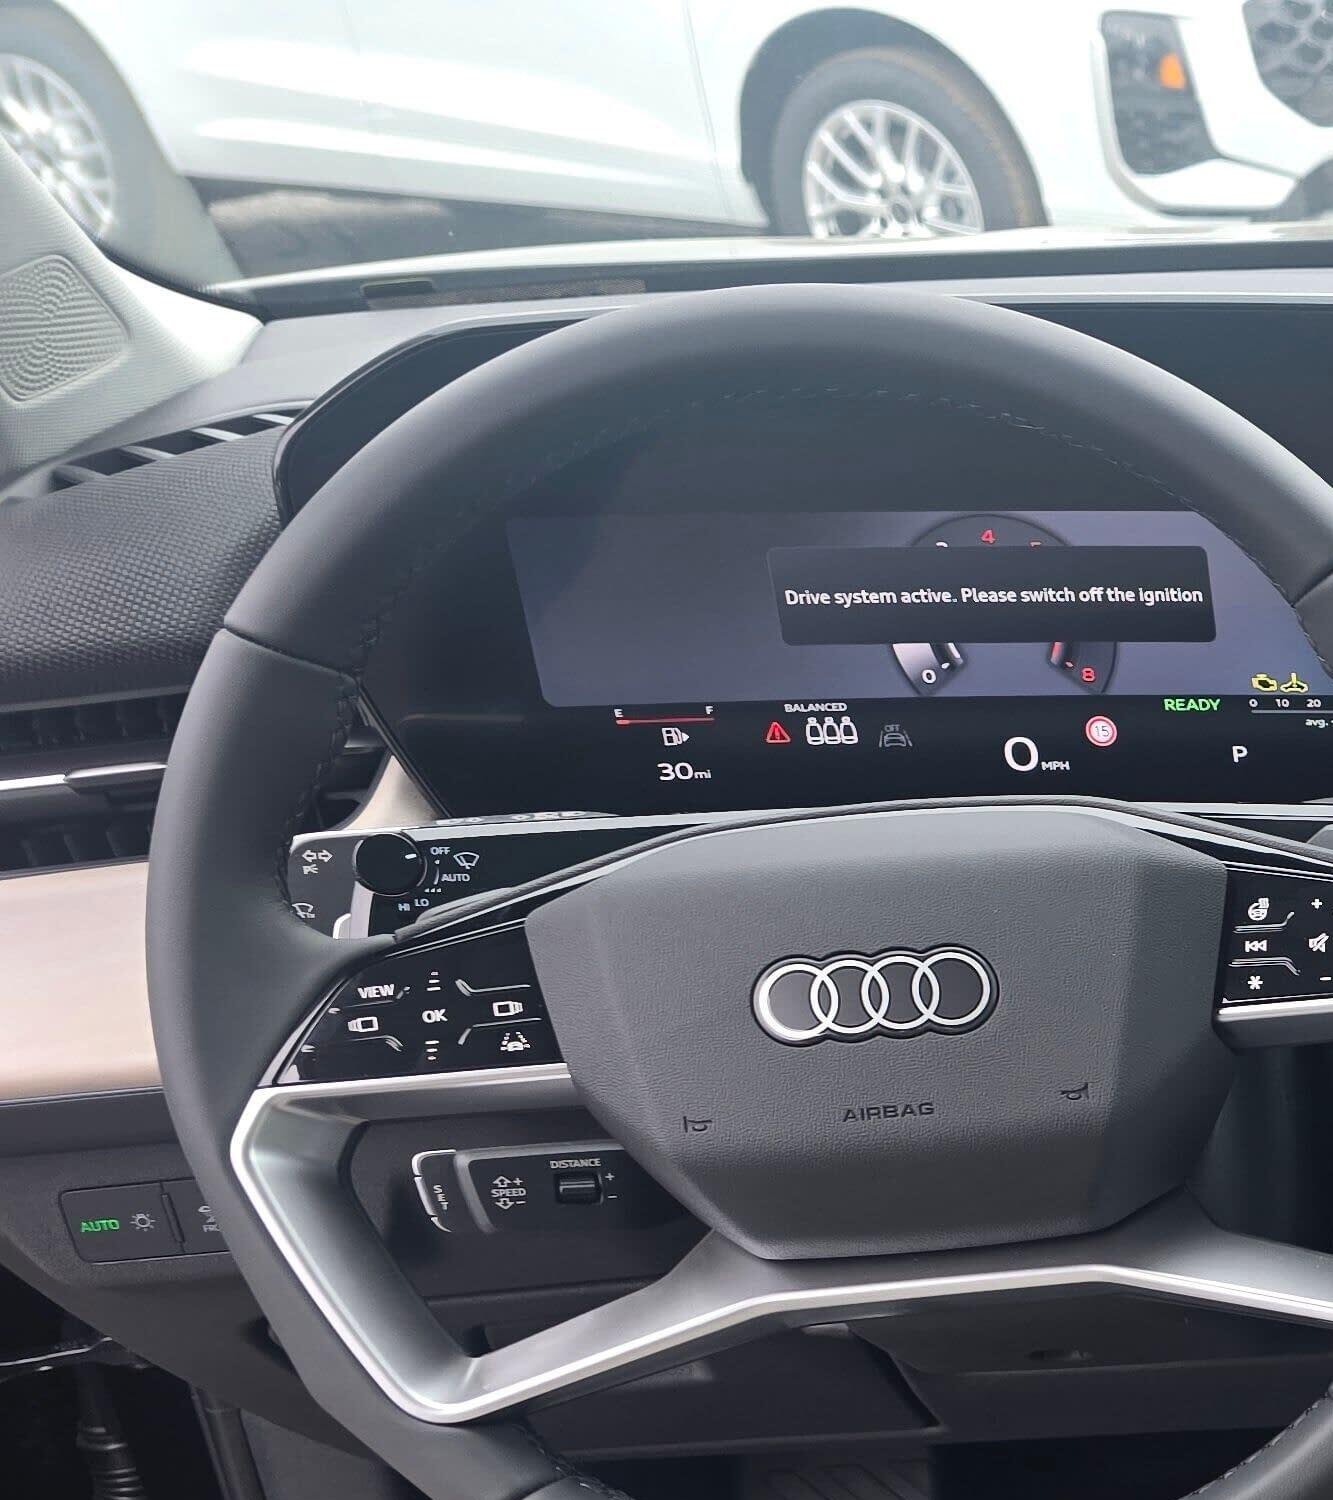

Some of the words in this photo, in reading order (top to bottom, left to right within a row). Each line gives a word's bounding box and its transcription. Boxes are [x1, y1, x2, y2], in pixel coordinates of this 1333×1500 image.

[981, 529, 996, 544] 4
[785, 589, 830, 606] Drive
[834, 589, 898, 608] system
[901, 588, 958, 604] active.
[961, 587, 1017, 603] Please
[1020, 587, 1075, 602] switch
[1079, 586, 1103, 602] off
[1106, 587, 1135, 602] the
[1138, 587, 1203, 606] ignition
[1081, 667, 1096, 682] 8
[784, 703, 848, 713] BALANCED
[1164, 699, 1221, 712] READY
[1275, 699, 1290, 707] 10
[1306, 699, 1322, 707] 20
[614, 708, 623, 718] E
[705, 706, 714, 715] F
[1094, 725, 1110, 738] 15
[1232, 746, 1248, 763] P
[1041, 760, 1070, 771] MPH
[430, 847, 450, 856] OFF
[441, 873, 470, 882] AUTO
[414, 898, 430, 907] LO
[357, 984, 395, 999] VIEW
[422, 1009, 448, 1023] OK
[842, 1102, 935, 1123] AIRBAG
[550, 1158, 601, 1169] DISTANCE
[433, 1185, 448, 1210] SET
[491, 1188, 526, 1197] SPEED
[80, 1219, 120, 1233] AUTO
